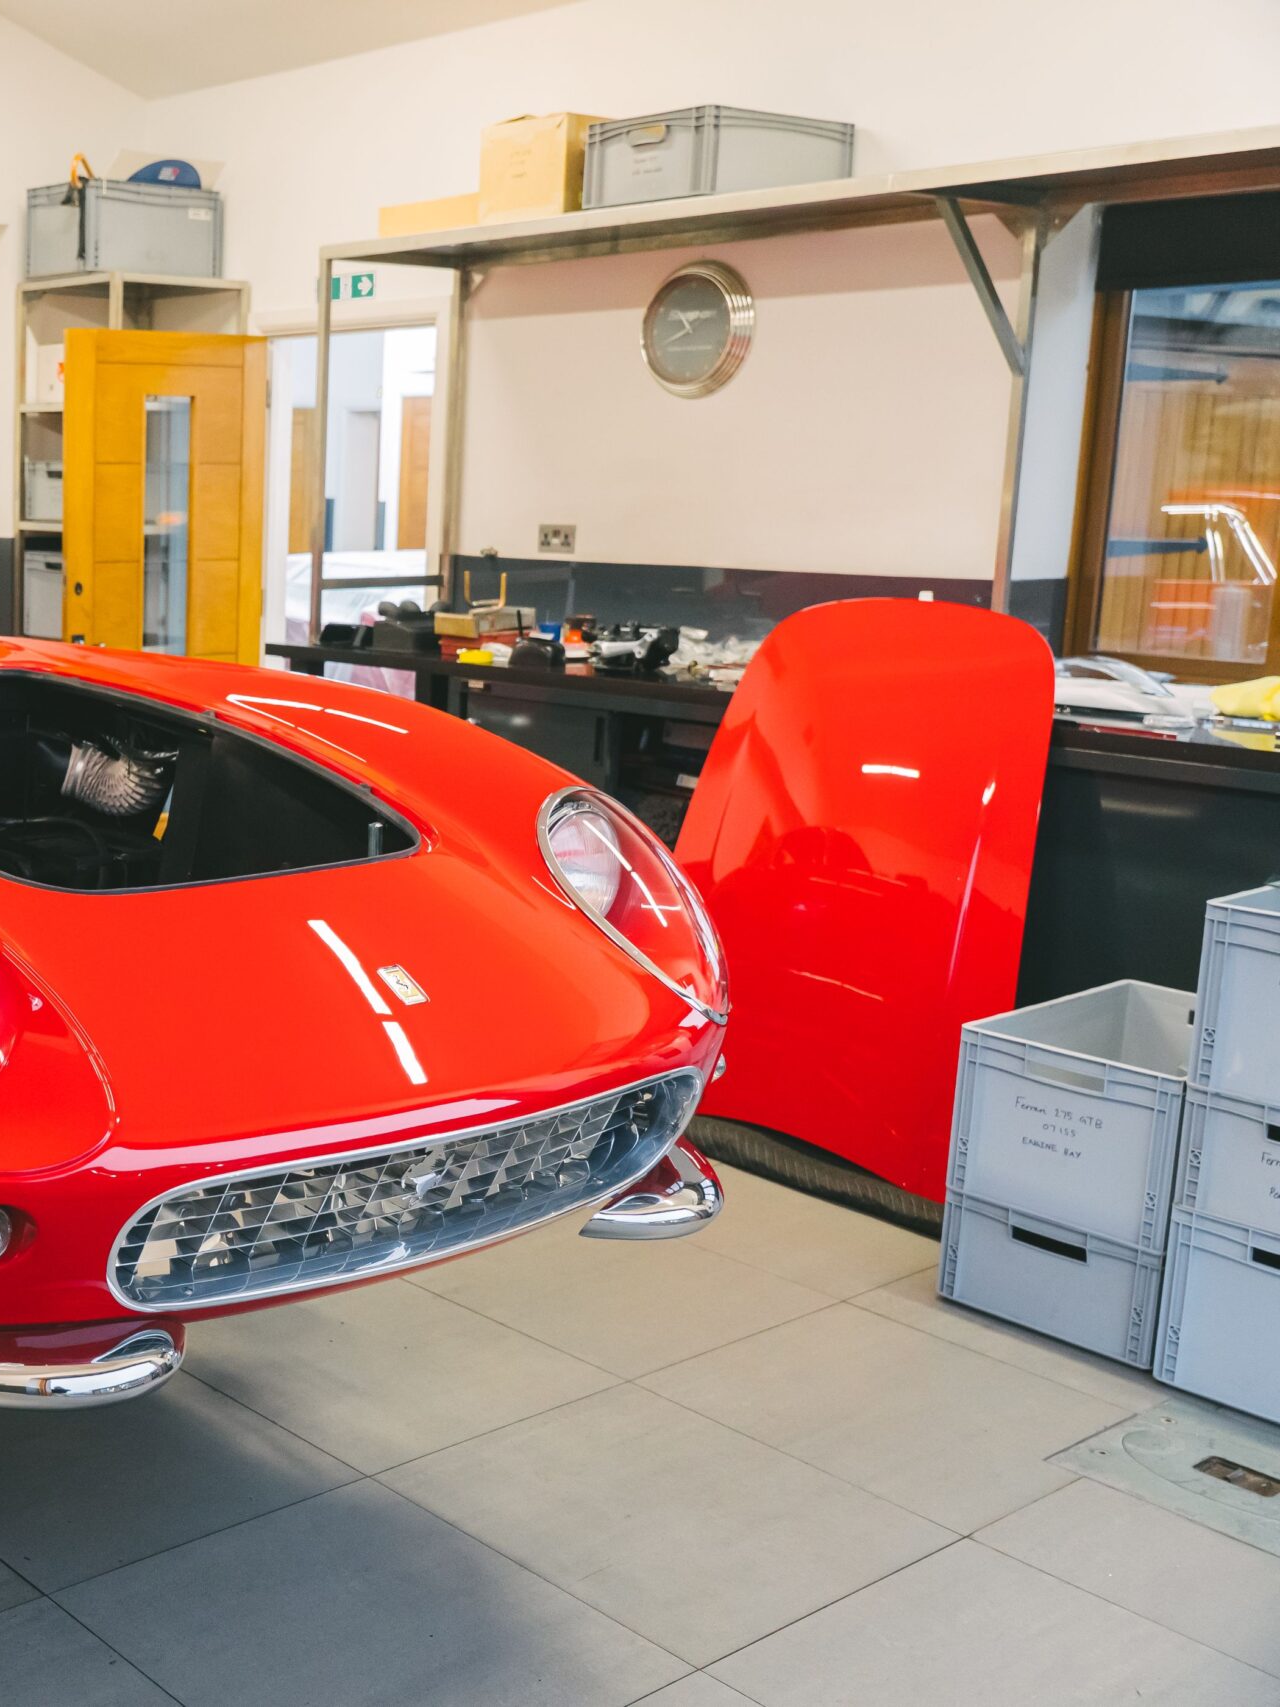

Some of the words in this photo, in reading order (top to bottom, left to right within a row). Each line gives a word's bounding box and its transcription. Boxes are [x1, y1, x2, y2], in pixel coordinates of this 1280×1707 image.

[1054, 1108, 1072, 1121] 275
[1079, 1115, 1103, 1129] GTB
[1022, 1136, 1057, 1152] ENGINE
[1063, 1147, 1081, 1158] BAY
